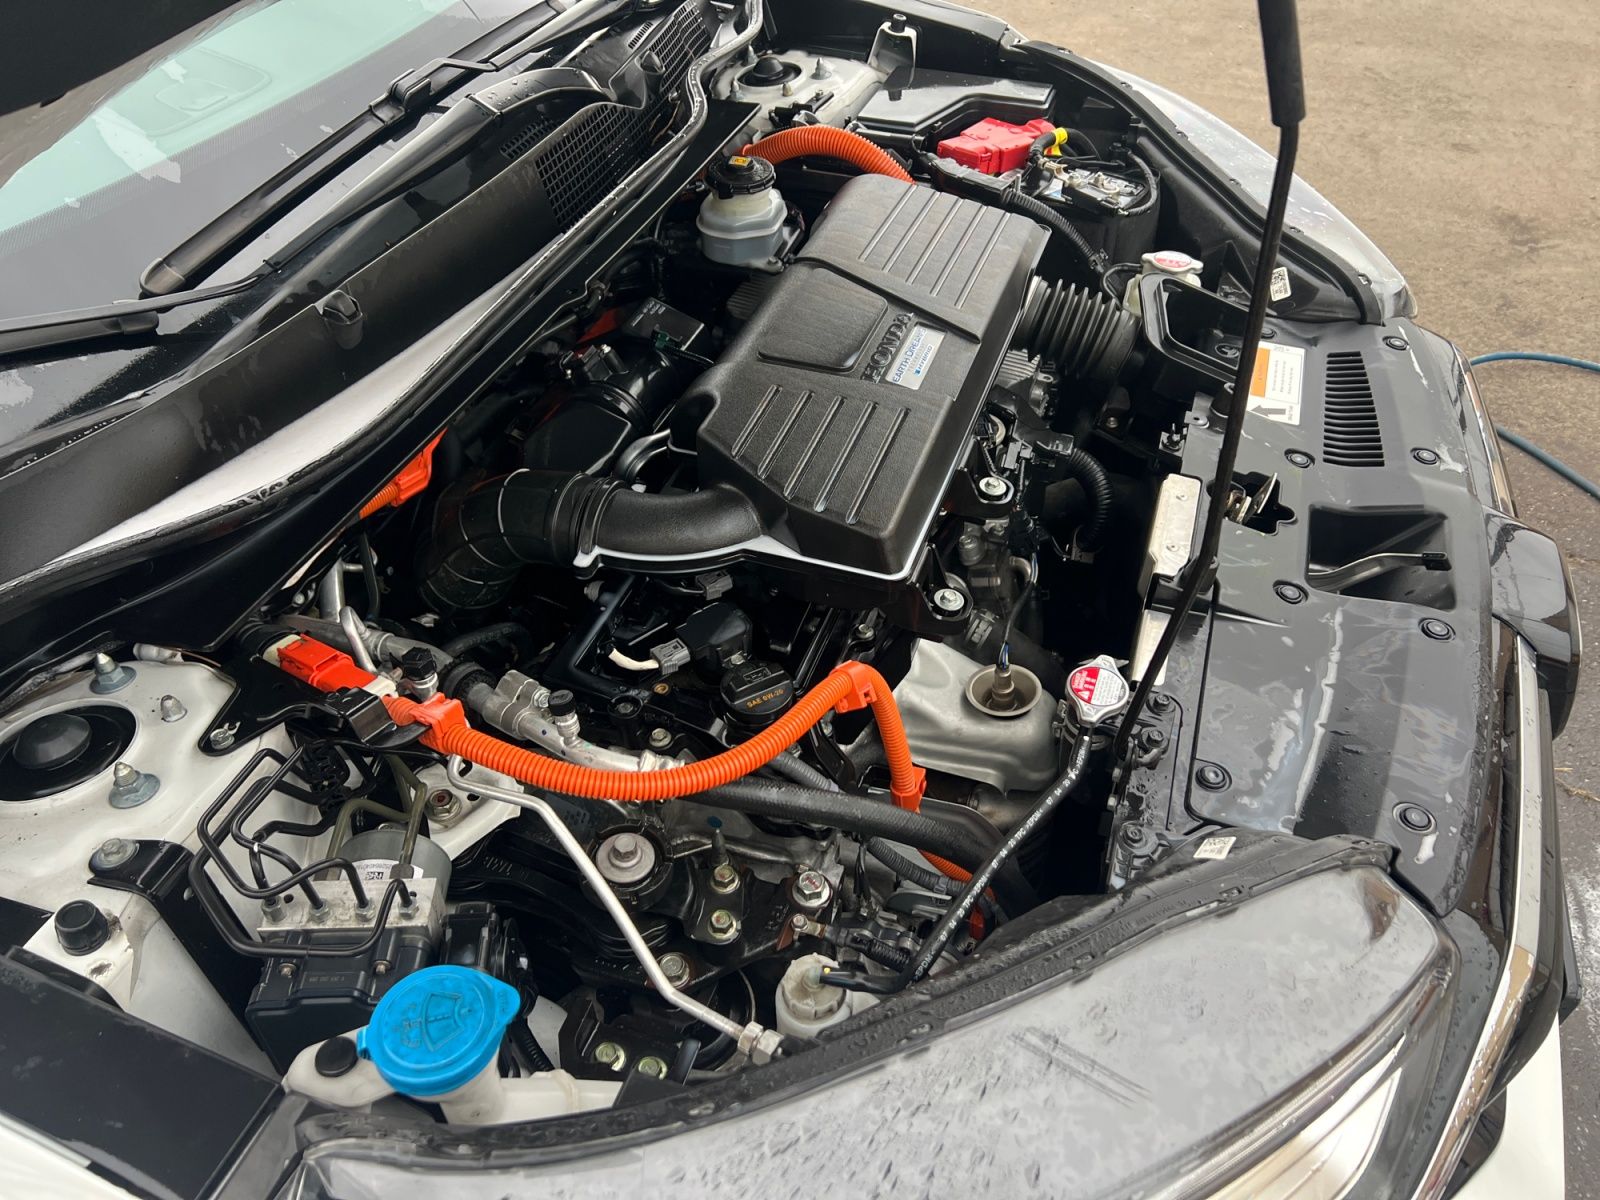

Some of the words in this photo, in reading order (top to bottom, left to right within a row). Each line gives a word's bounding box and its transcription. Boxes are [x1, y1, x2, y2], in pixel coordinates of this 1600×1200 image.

[860, 312, 914, 384] HONDA
[892, 356, 911, 382] EARTH
[746, 698, 762, 708] SAE
